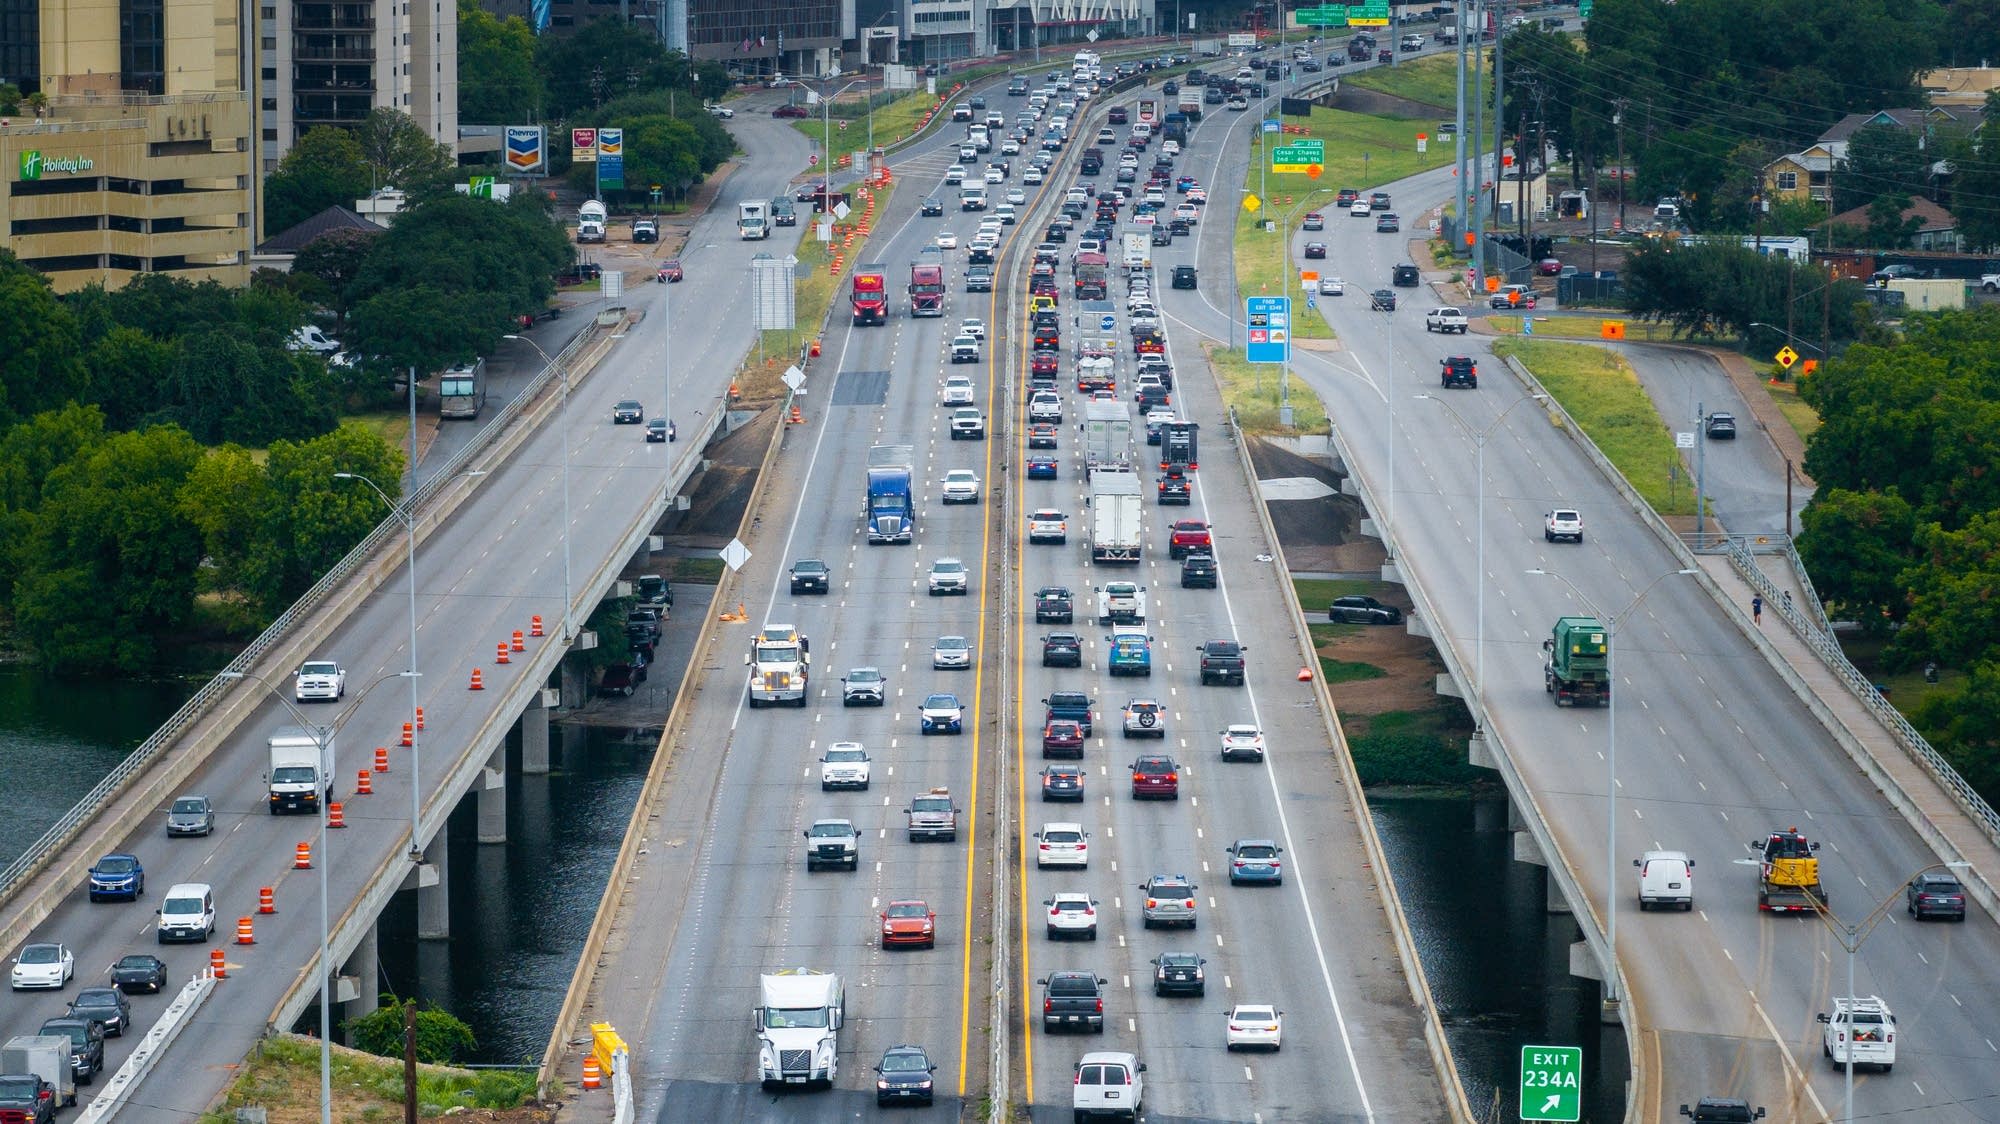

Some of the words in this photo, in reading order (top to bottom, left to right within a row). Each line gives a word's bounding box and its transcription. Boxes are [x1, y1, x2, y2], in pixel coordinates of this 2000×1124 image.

[43, 156, 78, 174] Holiday
[78, 155, 93, 170] Inn
[1533, 1053, 1569, 1065] EXIT
[1525, 1070, 1577, 1088] 234A
